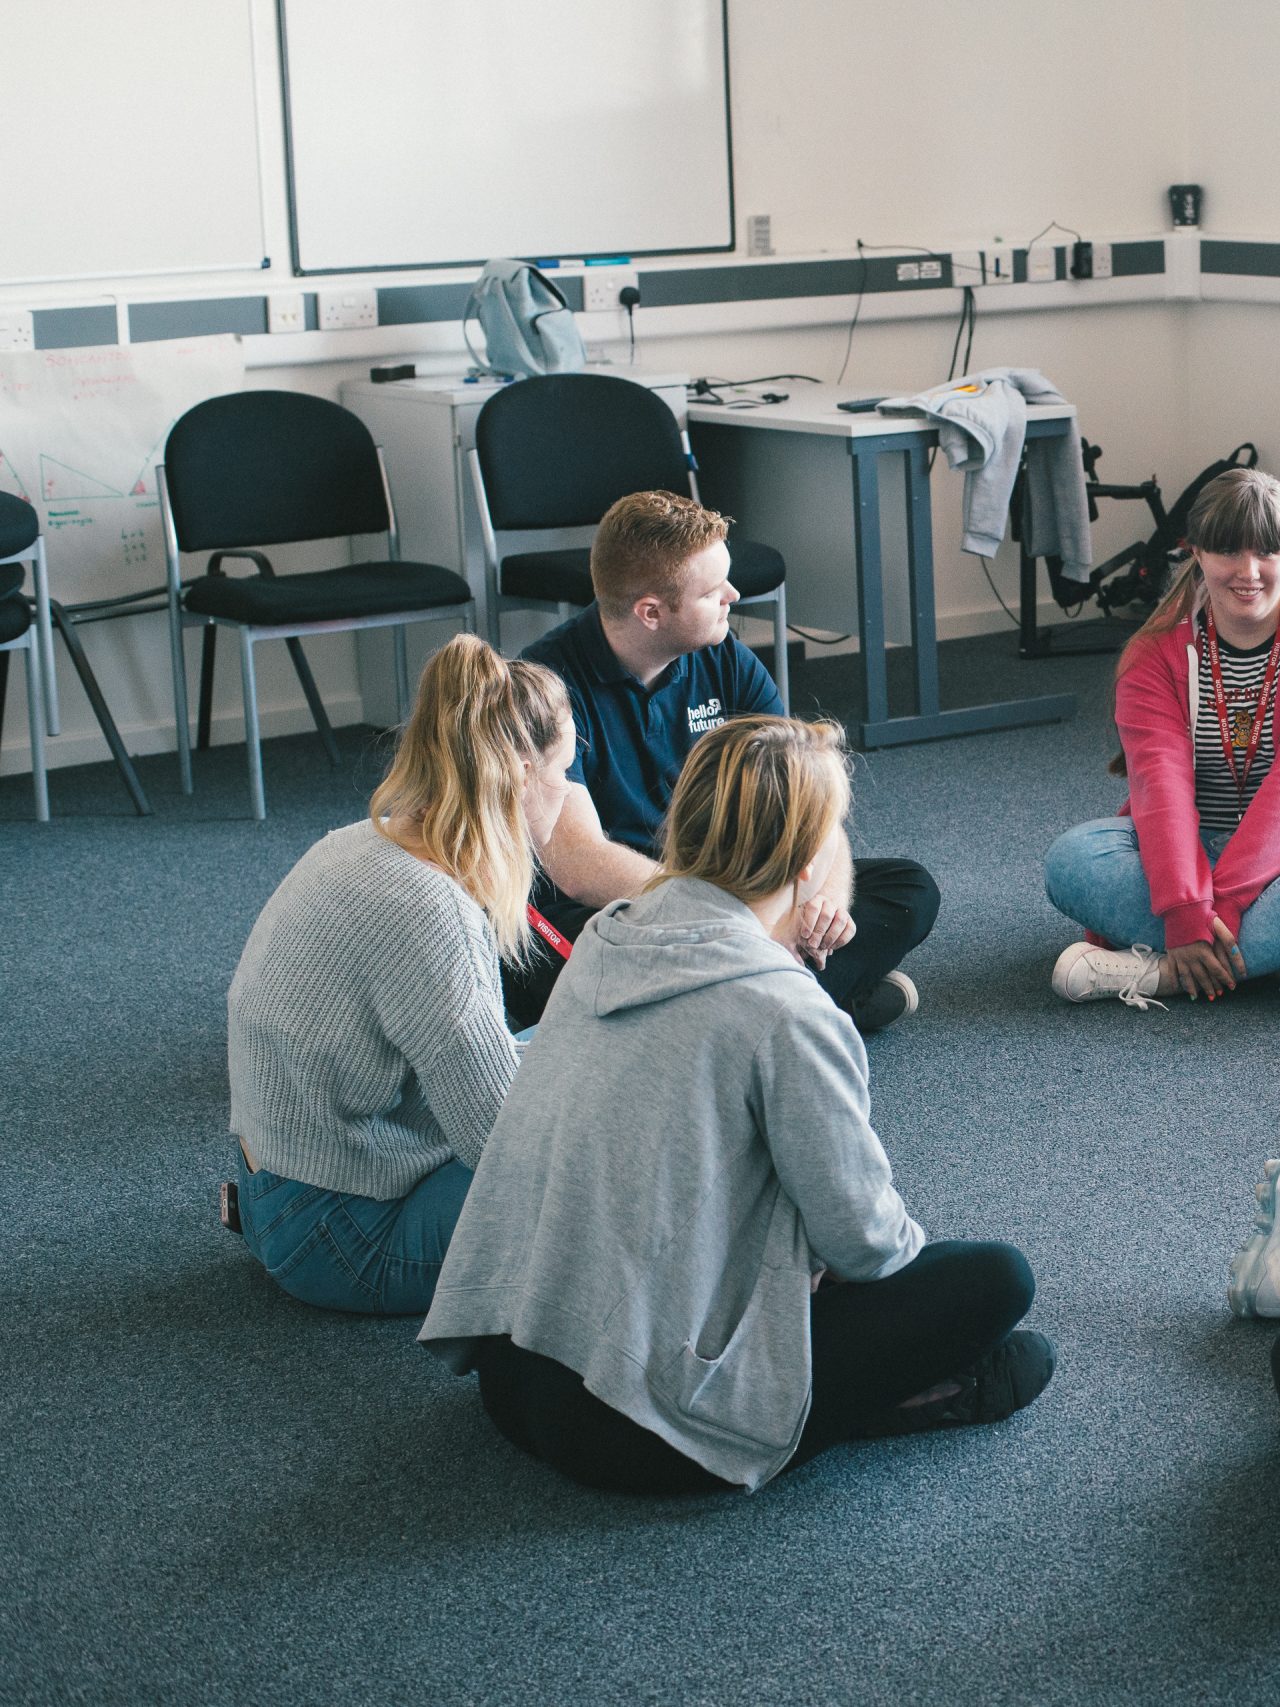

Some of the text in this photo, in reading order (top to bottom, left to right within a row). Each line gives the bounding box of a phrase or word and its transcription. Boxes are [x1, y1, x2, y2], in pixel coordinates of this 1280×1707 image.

[1210, 640, 1218, 665] VISITOR
[1270, 642, 1280, 667] VISITOR
[1215, 679, 1224, 704] VISITOR
[1260, 681, 1271, 706] VISITOR
[1220, 718, 1229, 744] VISITOR
[1250, 720, 1261, 745] VISITOR
[537, 920, 561, 946] VISITOR
